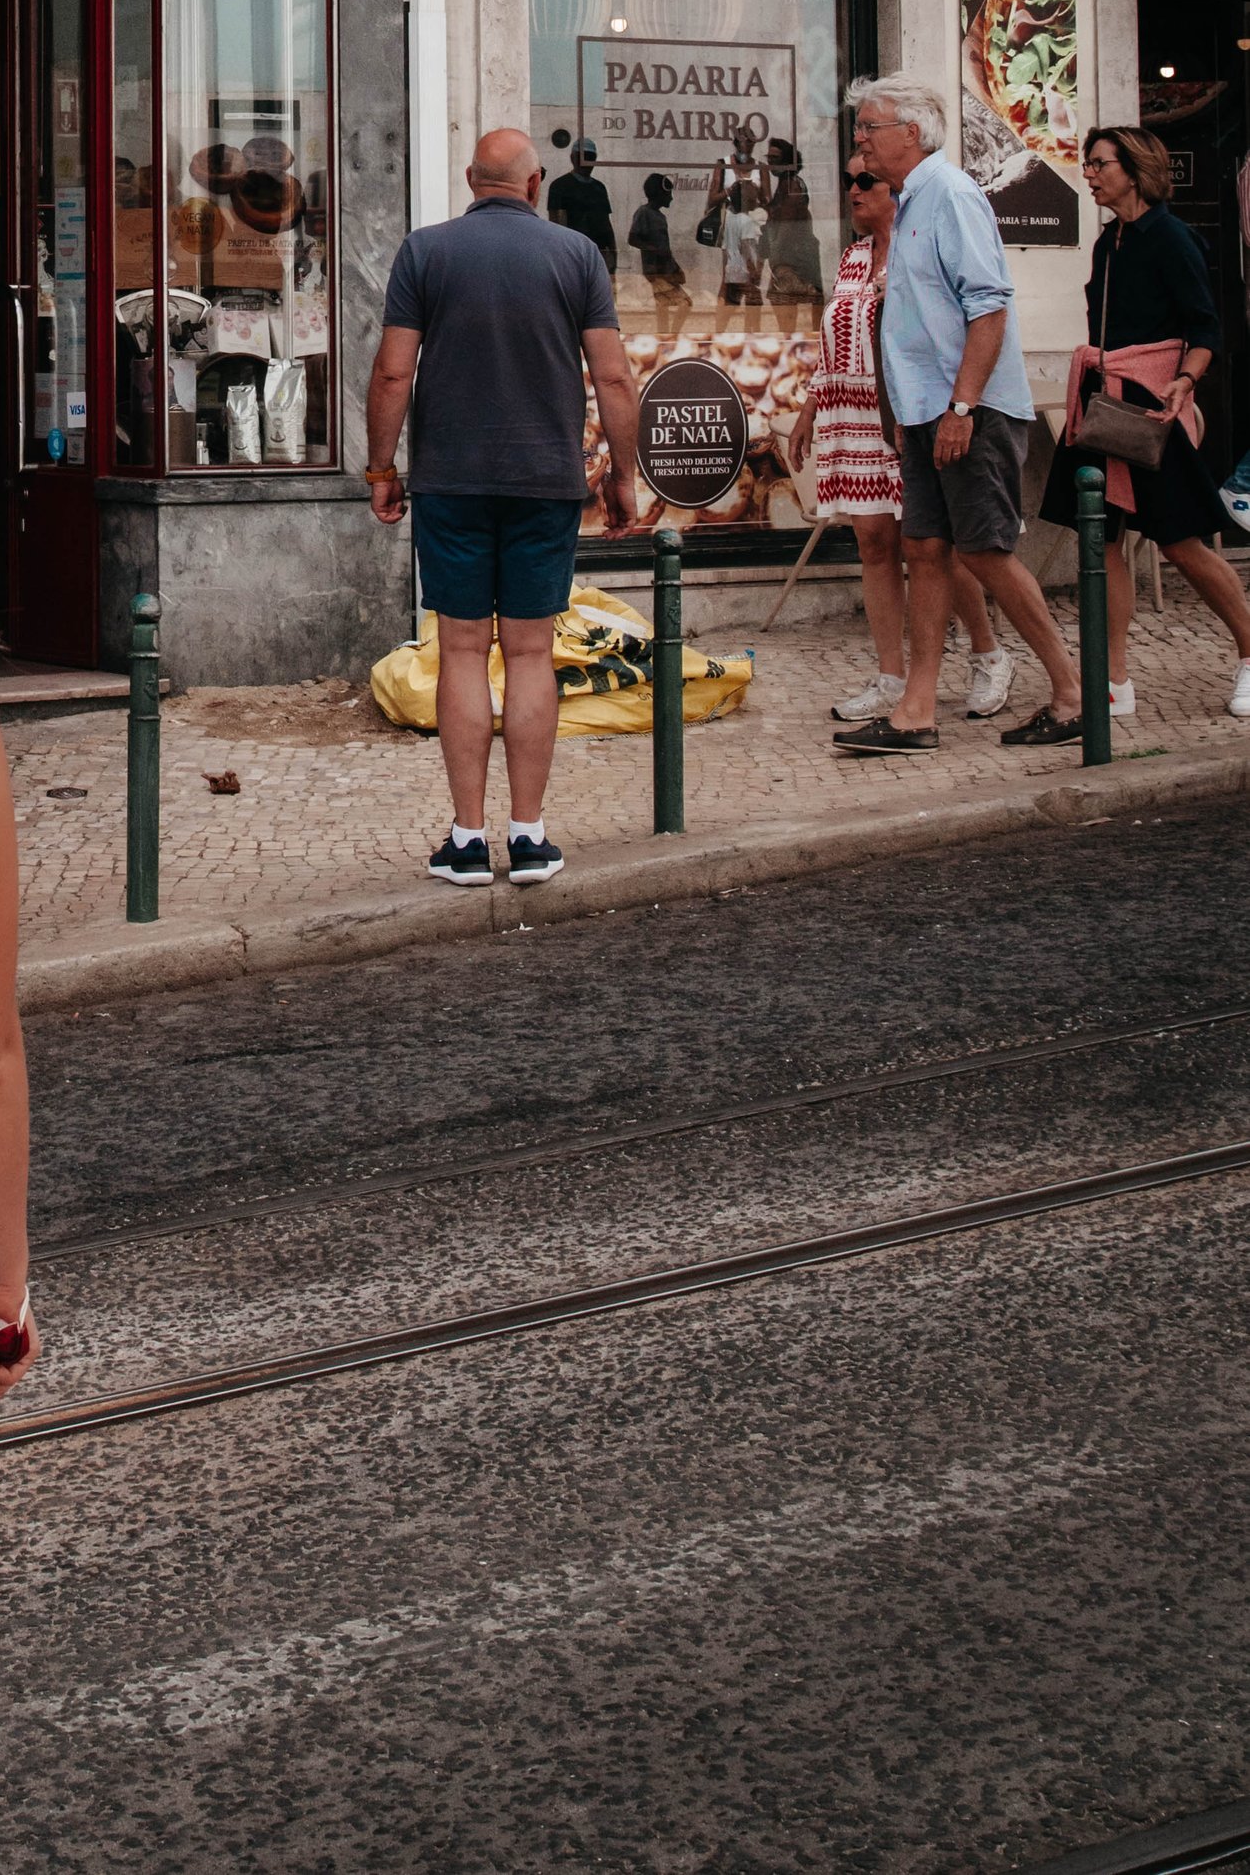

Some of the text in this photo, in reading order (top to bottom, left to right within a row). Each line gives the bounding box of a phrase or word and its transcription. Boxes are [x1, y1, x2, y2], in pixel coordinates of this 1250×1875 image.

[604, 61, 769, 97] PADARIA
[602, 108, 770, 143] DO BAIRRO
[662, 172, 714, 192] Chiad
[182, 212, 216, 223] VEGAN
[996, 216, 1020, 226] DARIA
[1030, 217, 1060, 226] BAIRRO
[187, 226, 213, 236] NATA
[227, 239, 257, 248] PASTEL
[259, 239, 271, 248] DE
[69, 405, 86, 415] VISA
[656, 405, 727, 424] PASTEL
[651, 425, 732, 445] DE NATA
[650, 456, 733, 467] FRESH AND DELICIOUS
[654, 468, 683, 476] FRESCO
[691, 466, 730, 475] DELICIOSO
